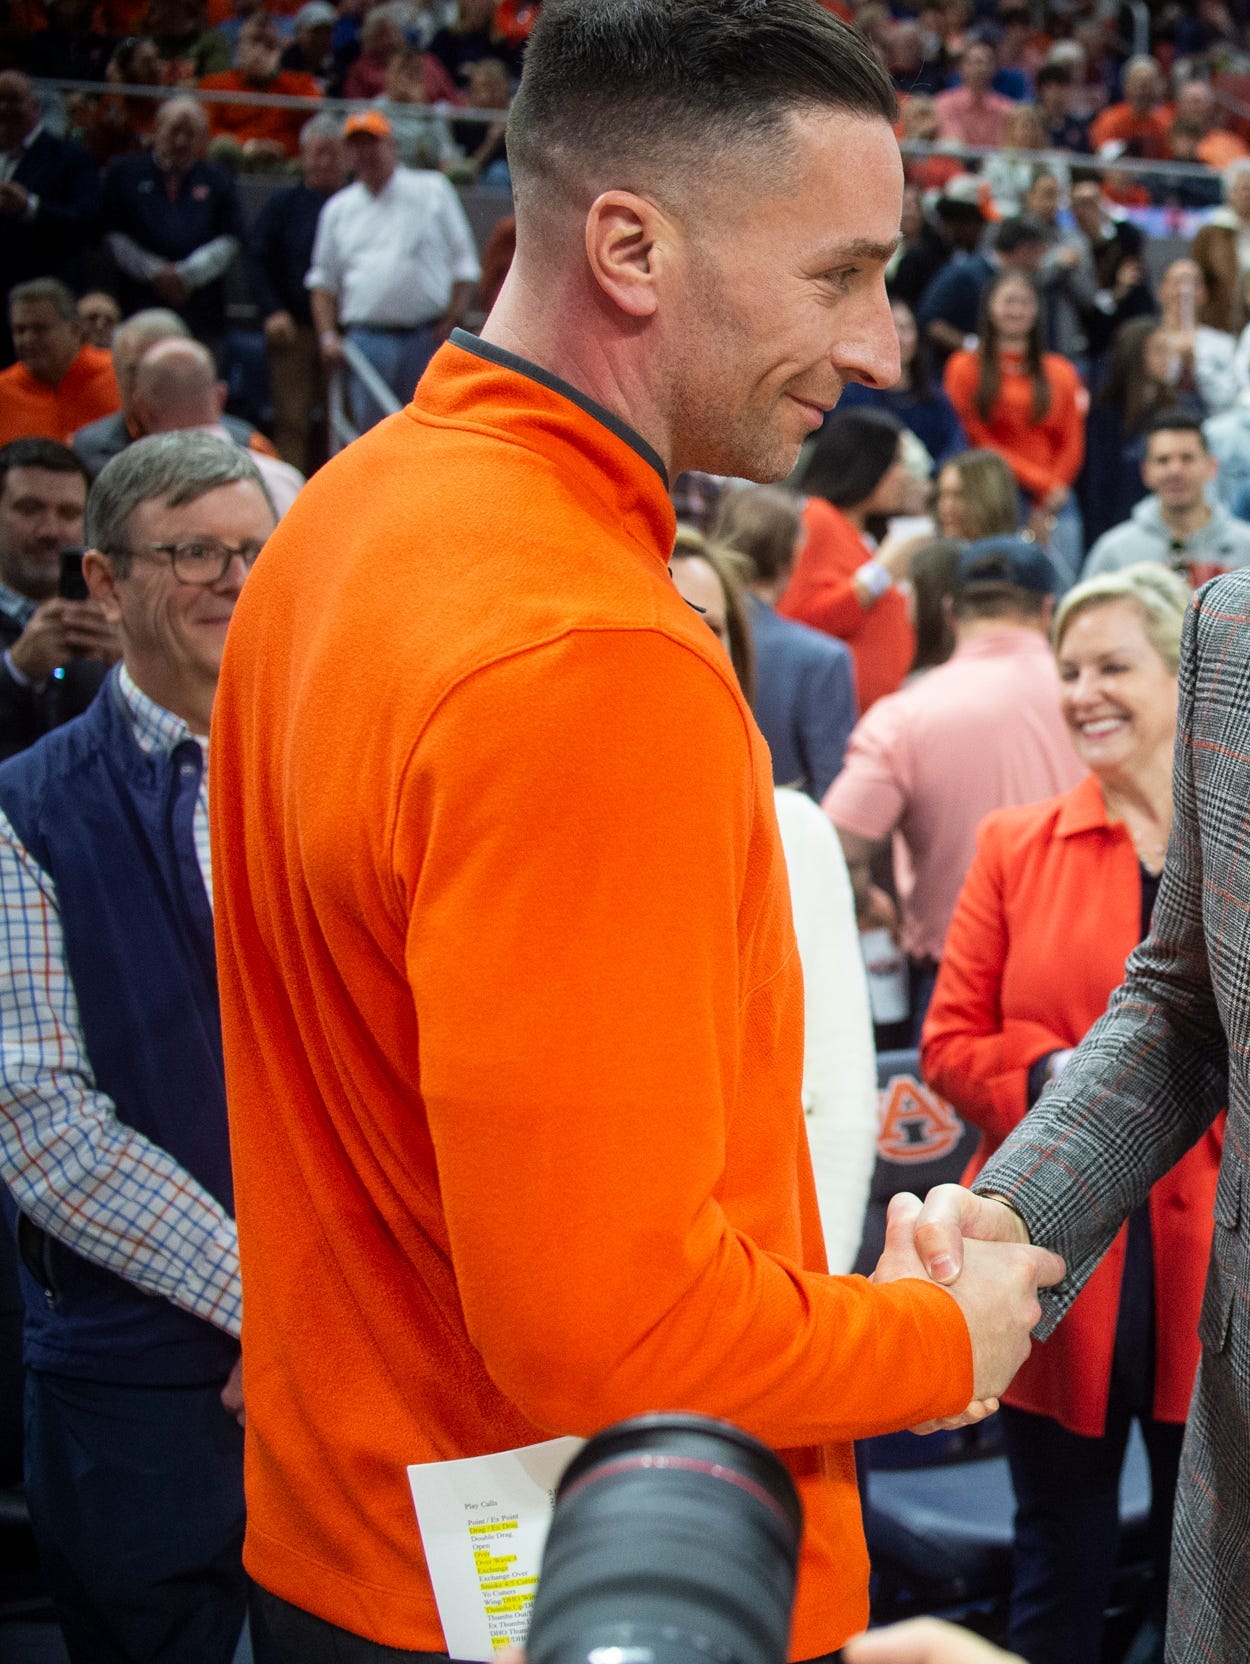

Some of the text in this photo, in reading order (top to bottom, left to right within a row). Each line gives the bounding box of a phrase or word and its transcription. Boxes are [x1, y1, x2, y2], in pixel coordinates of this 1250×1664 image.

[481, 1500, 498, 1508] Calls
[471, 1534, 495, 1542] Double
[472, 1543, 490, 1551] Open
[479, 1573, 510, 1583] Exchange
